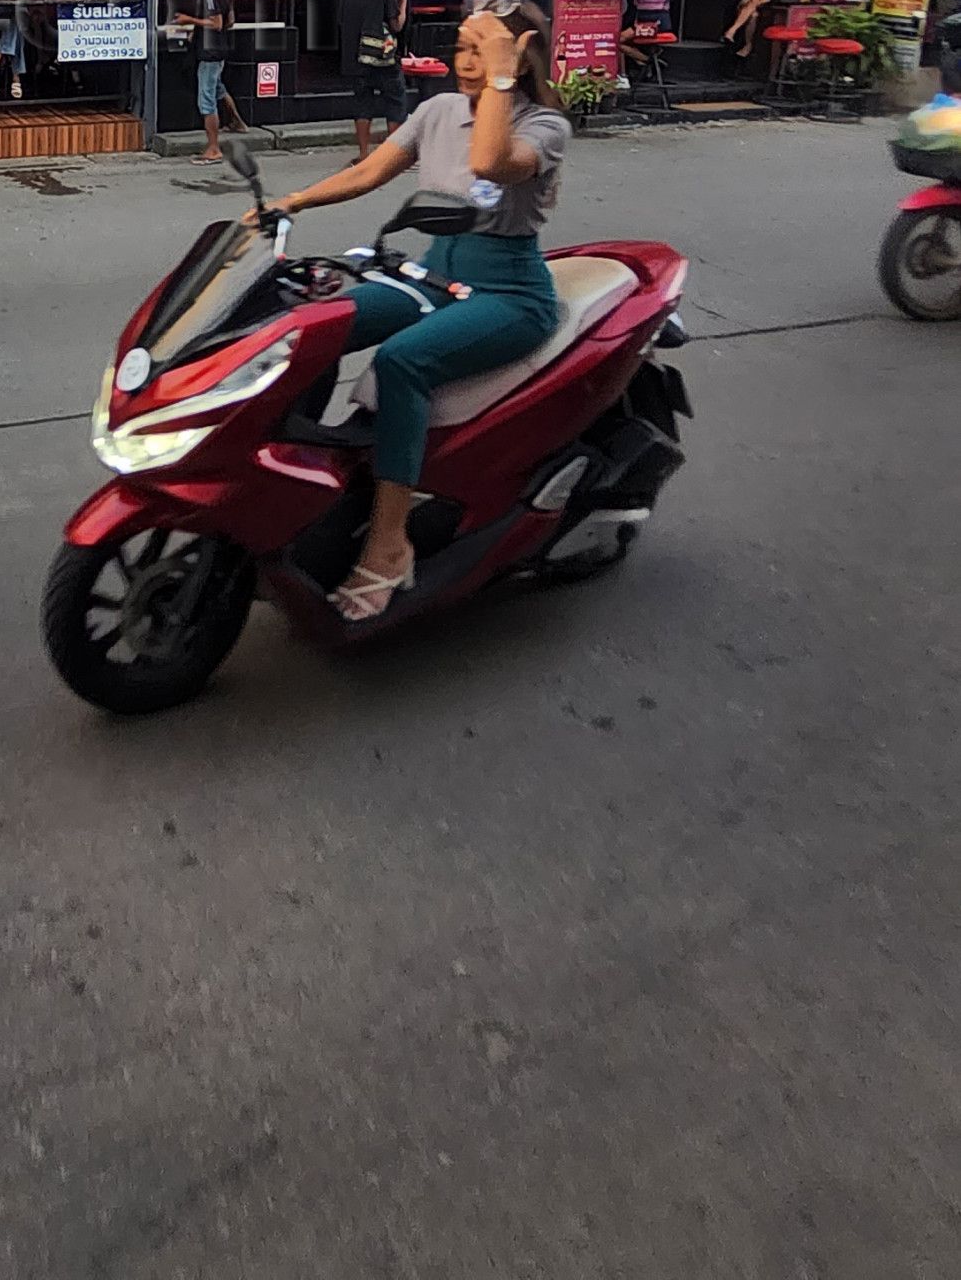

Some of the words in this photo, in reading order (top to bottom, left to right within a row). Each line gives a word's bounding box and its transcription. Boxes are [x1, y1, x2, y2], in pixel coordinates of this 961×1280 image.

[72, 3, 132, 19] รับสมัคร
[60, 21, 145, 32] พนักงานสาวสวย
[74, 35, 130, 46] จำนวนมาก
[61, 48, 144, 59] 089-0931926
